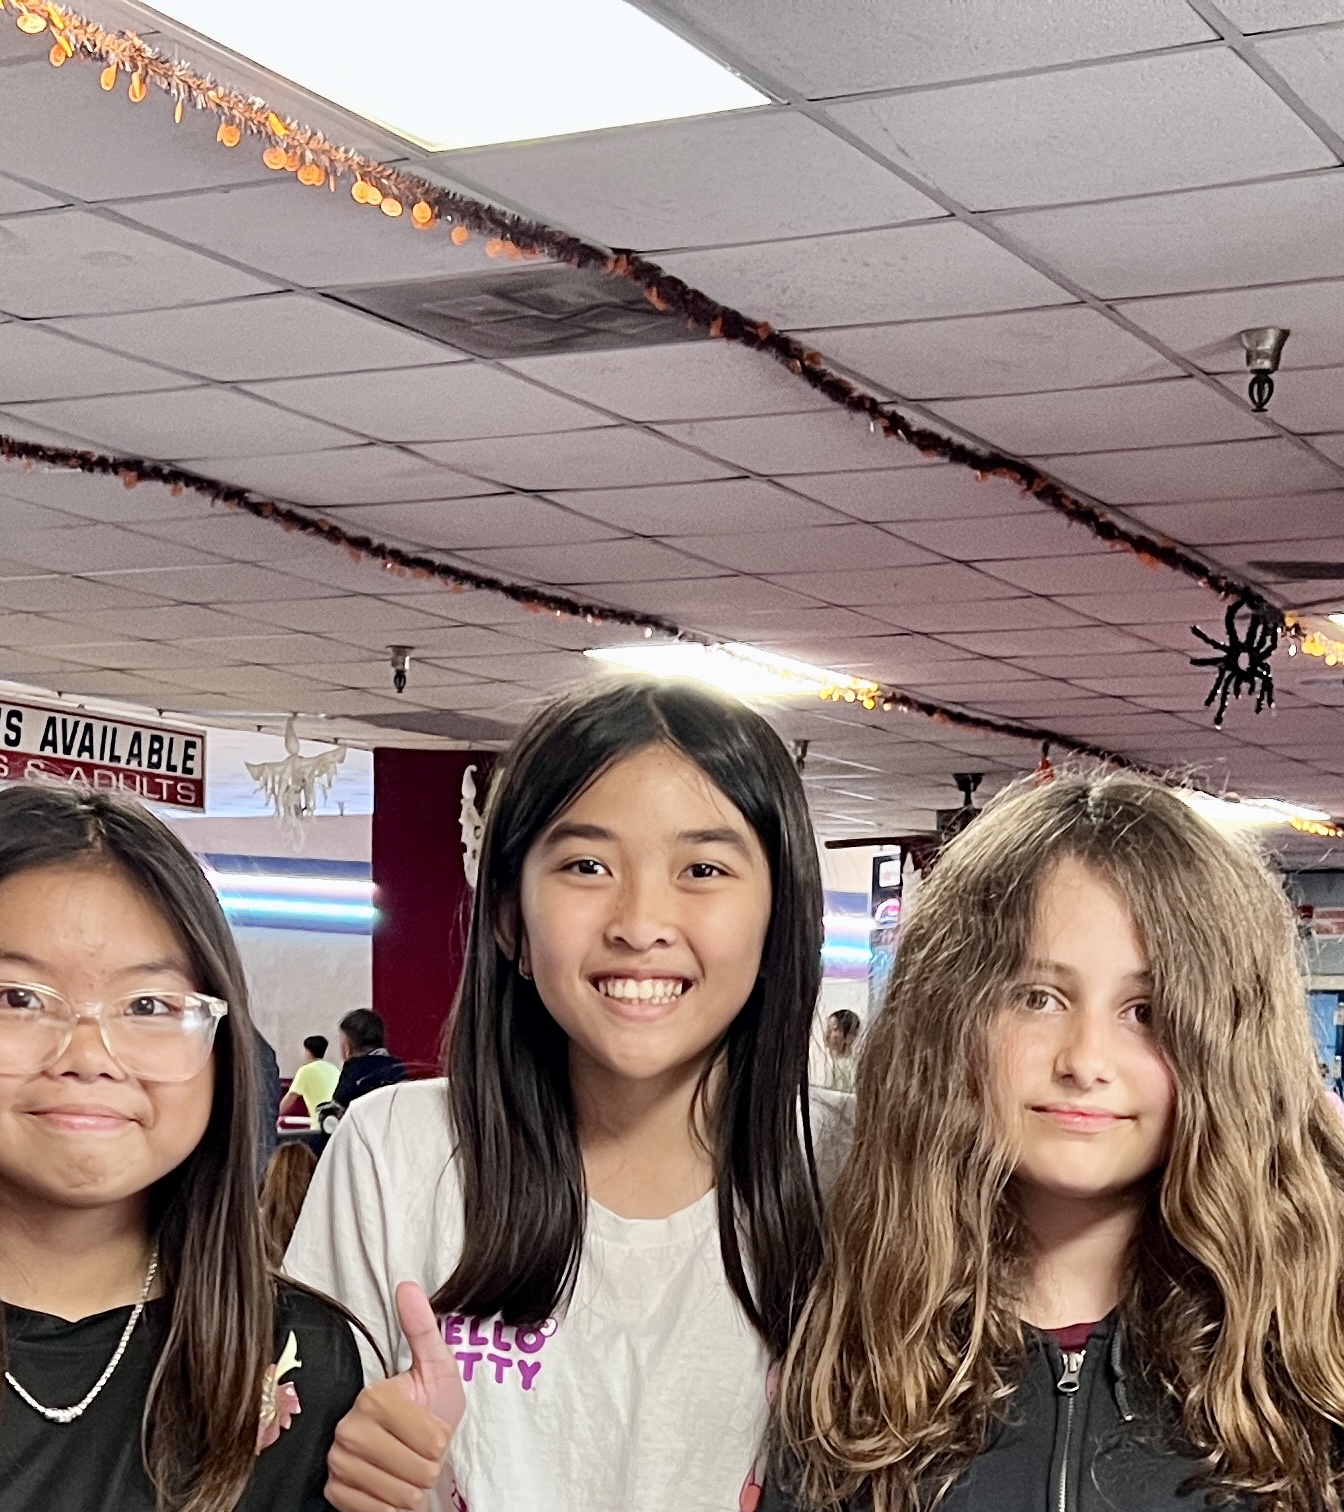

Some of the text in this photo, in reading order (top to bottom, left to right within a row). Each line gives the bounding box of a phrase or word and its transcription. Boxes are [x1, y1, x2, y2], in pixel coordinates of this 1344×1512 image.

[39, 715, 197, 776] AVAILABLE
[67, 766, 197, 804] ADULTS
[438, 1315, 546, 1354] ELLO
[455, 1351, 542, 1391] TTY
